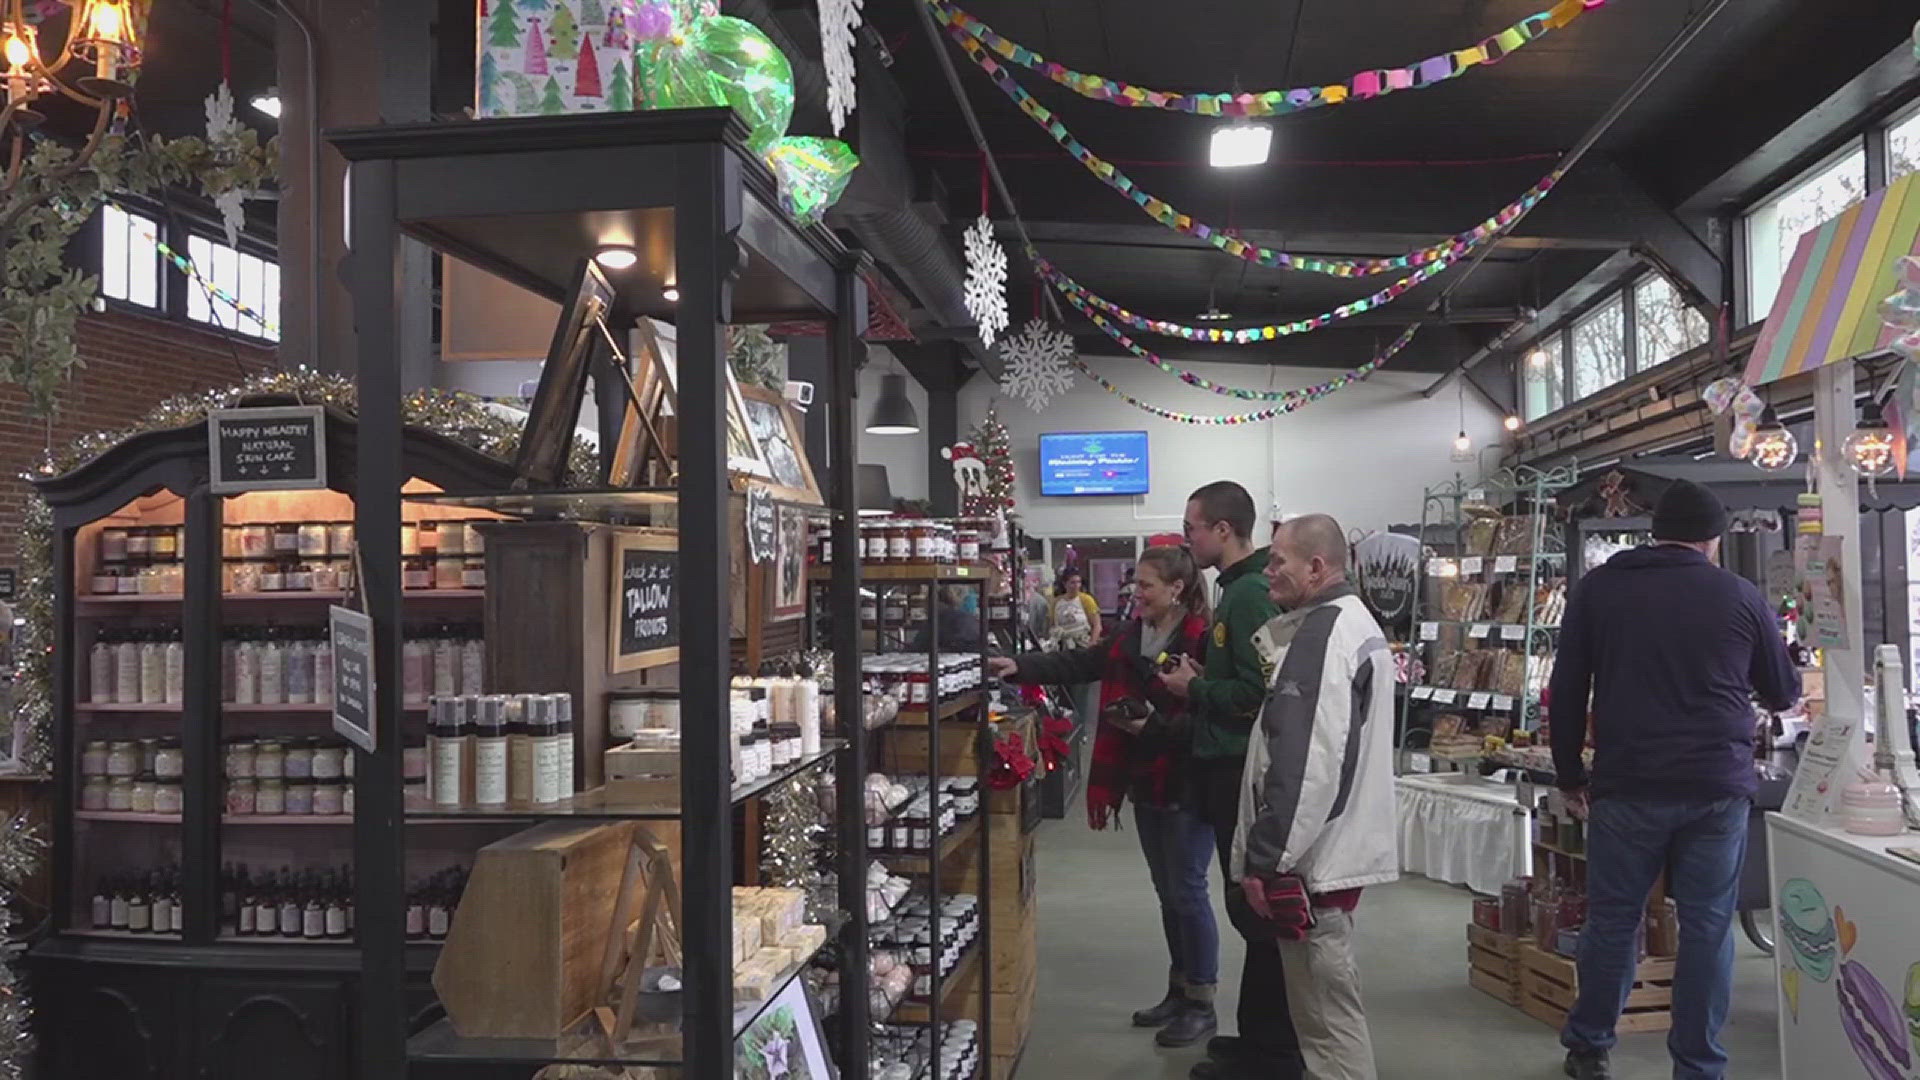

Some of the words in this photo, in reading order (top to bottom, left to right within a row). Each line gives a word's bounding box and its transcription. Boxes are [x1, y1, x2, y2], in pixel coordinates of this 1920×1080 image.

[220, 427, 260, 438] HAPPY
[263, 424, 309, 437] HEALTHY
[242, 440, 295, 452] NATURAL
[236, 453, 263, 464] SKIN
[266, 451, 295, 462] CARE
[625, 583, 671, 618] TALLOW
